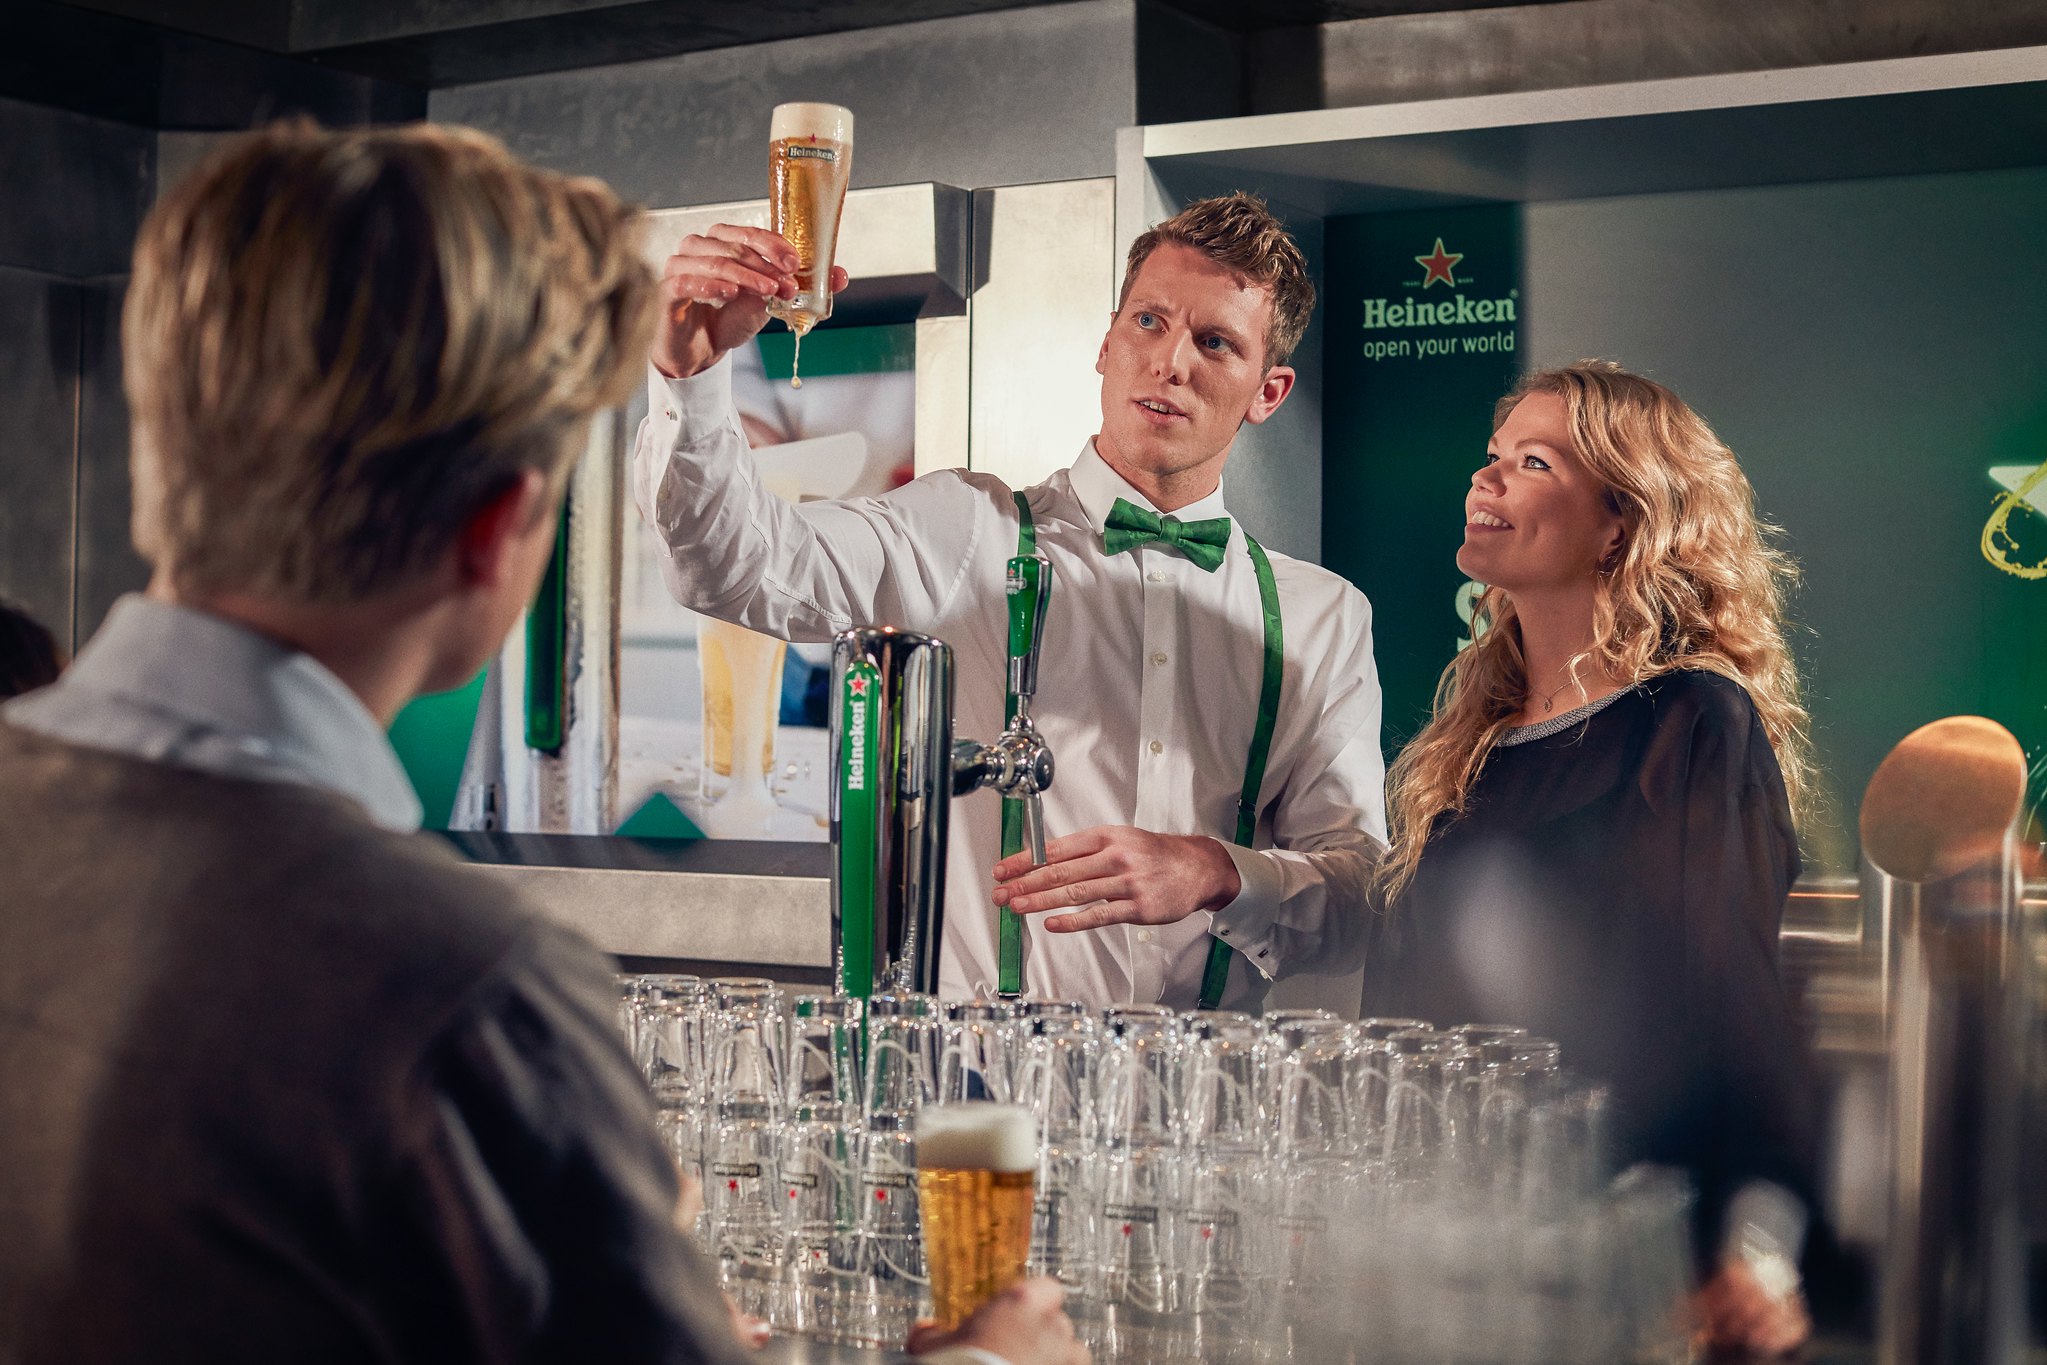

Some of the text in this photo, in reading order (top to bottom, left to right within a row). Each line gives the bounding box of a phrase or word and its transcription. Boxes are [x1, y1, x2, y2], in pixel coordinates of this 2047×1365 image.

[789, 147, 833, 160] Heineken
[1363, 294, 1516, 329] Heineken
[1363, 330, 1514, 361] open your world
[848, 701, 865, 790] Heineken
